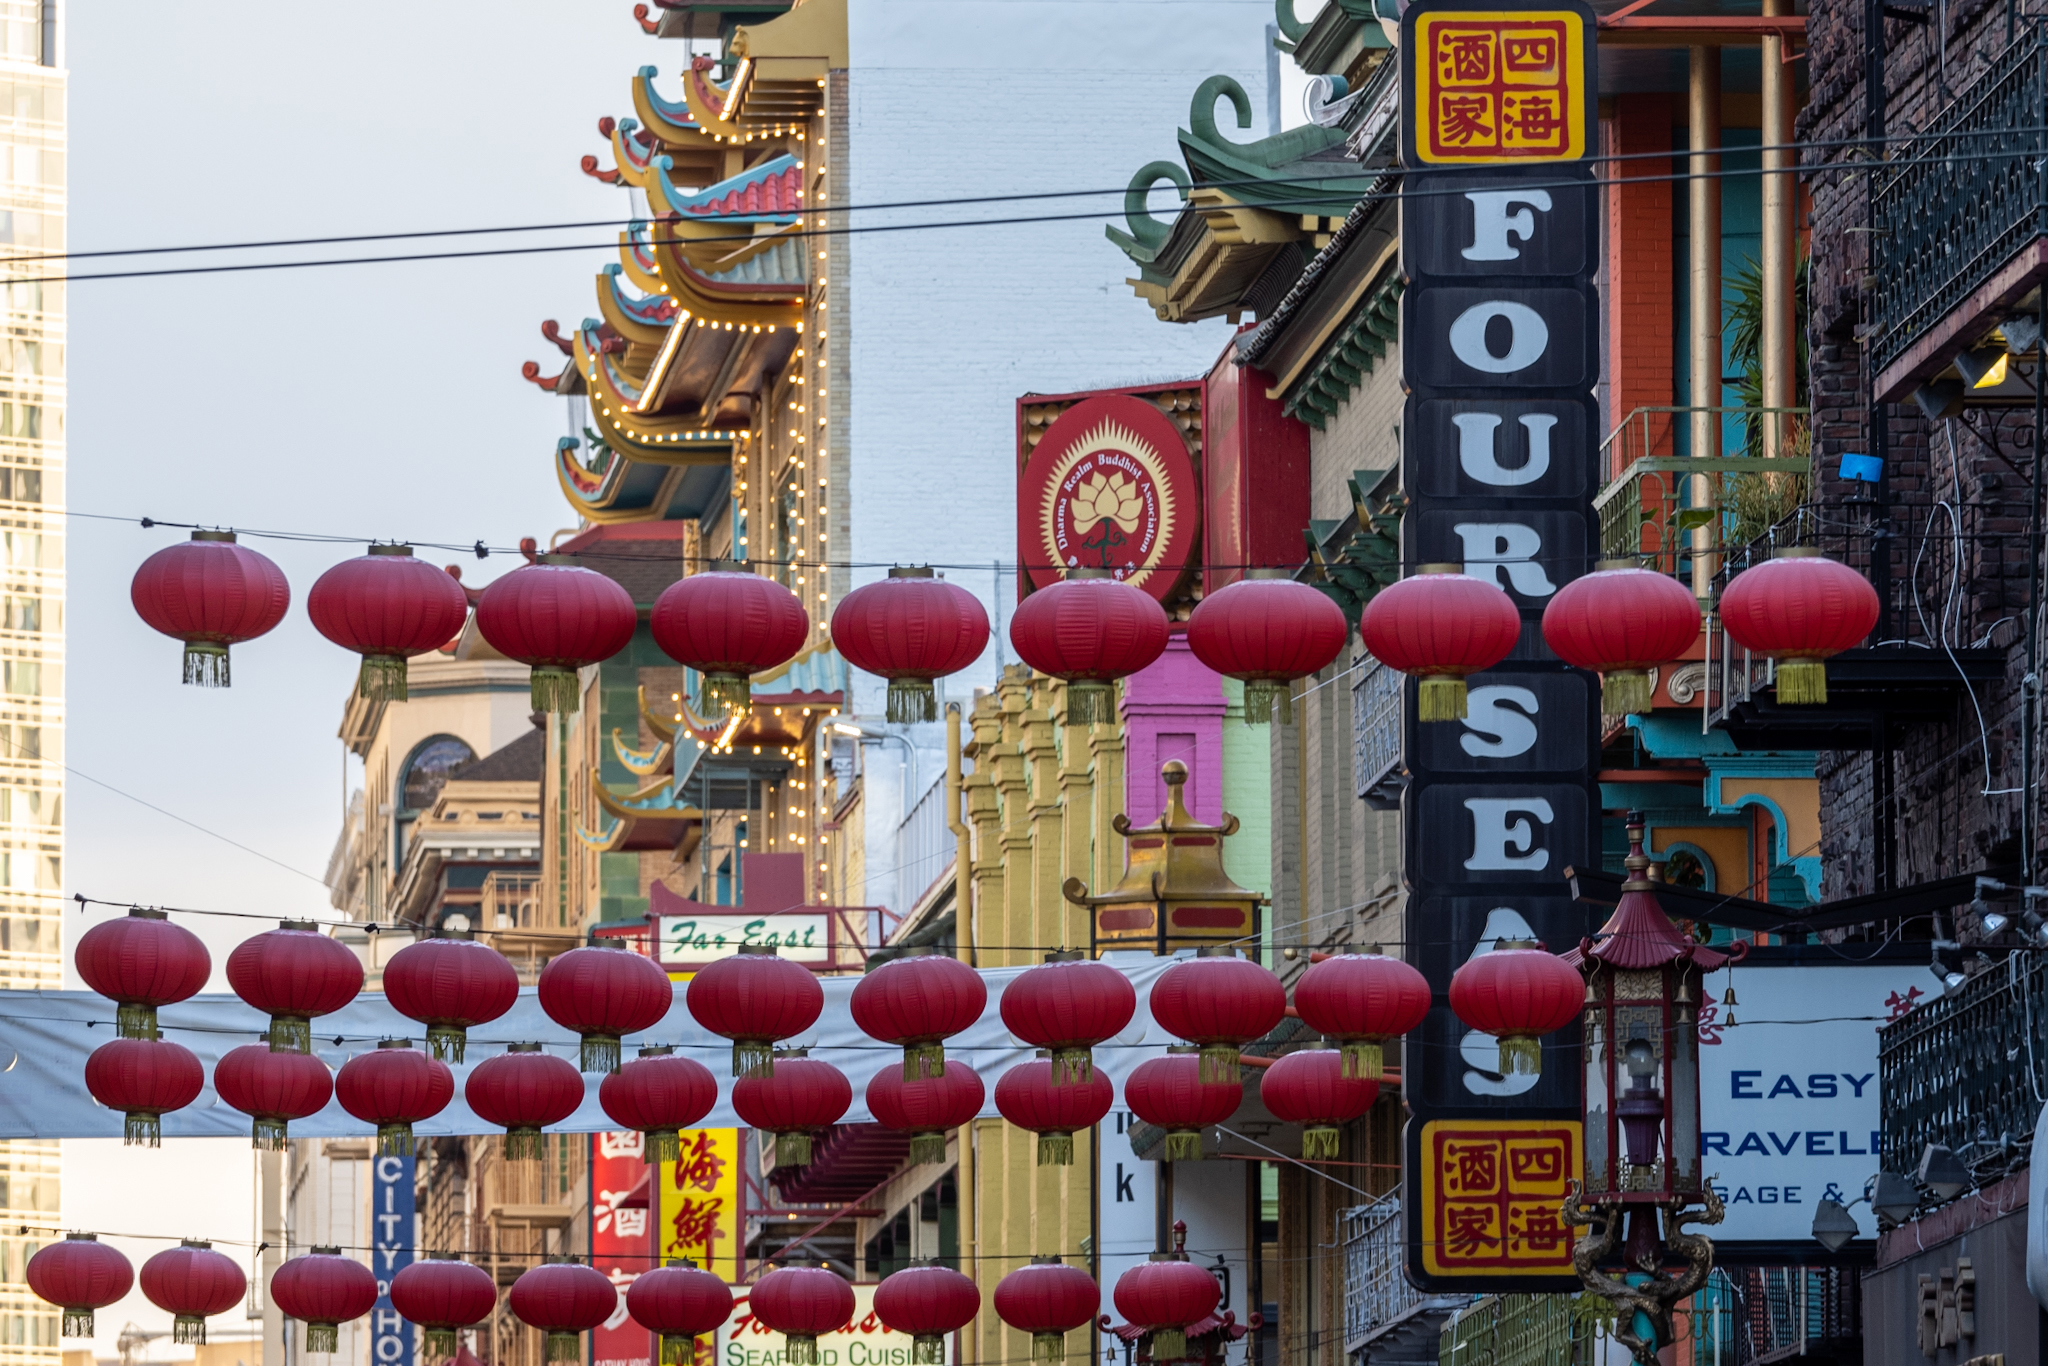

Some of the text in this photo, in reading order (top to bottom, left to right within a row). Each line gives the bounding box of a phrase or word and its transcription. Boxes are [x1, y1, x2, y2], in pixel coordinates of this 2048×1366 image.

[1449, 188, 1559, 598] FOUR
[1056, 453, 1157, 553] Dharma Realm Buddhist Association
[671, 920, 727, 954] Far
[742, 918, 815, 949] East
[1731, 1070, 1875, 1099] EASY
[1700, 1131, 1889, 1156] RAVELE
[1710, 1186, 1802, 1204] GAGE
[1822, 1182, 1844, 1204] &
[376, 1156, 403, 1271] CITY
[376, 1309, 404, 1366] HO
[726, 1342, 839, 1366] SEAFD
[848, 1341, 943, 1366] CUISI
